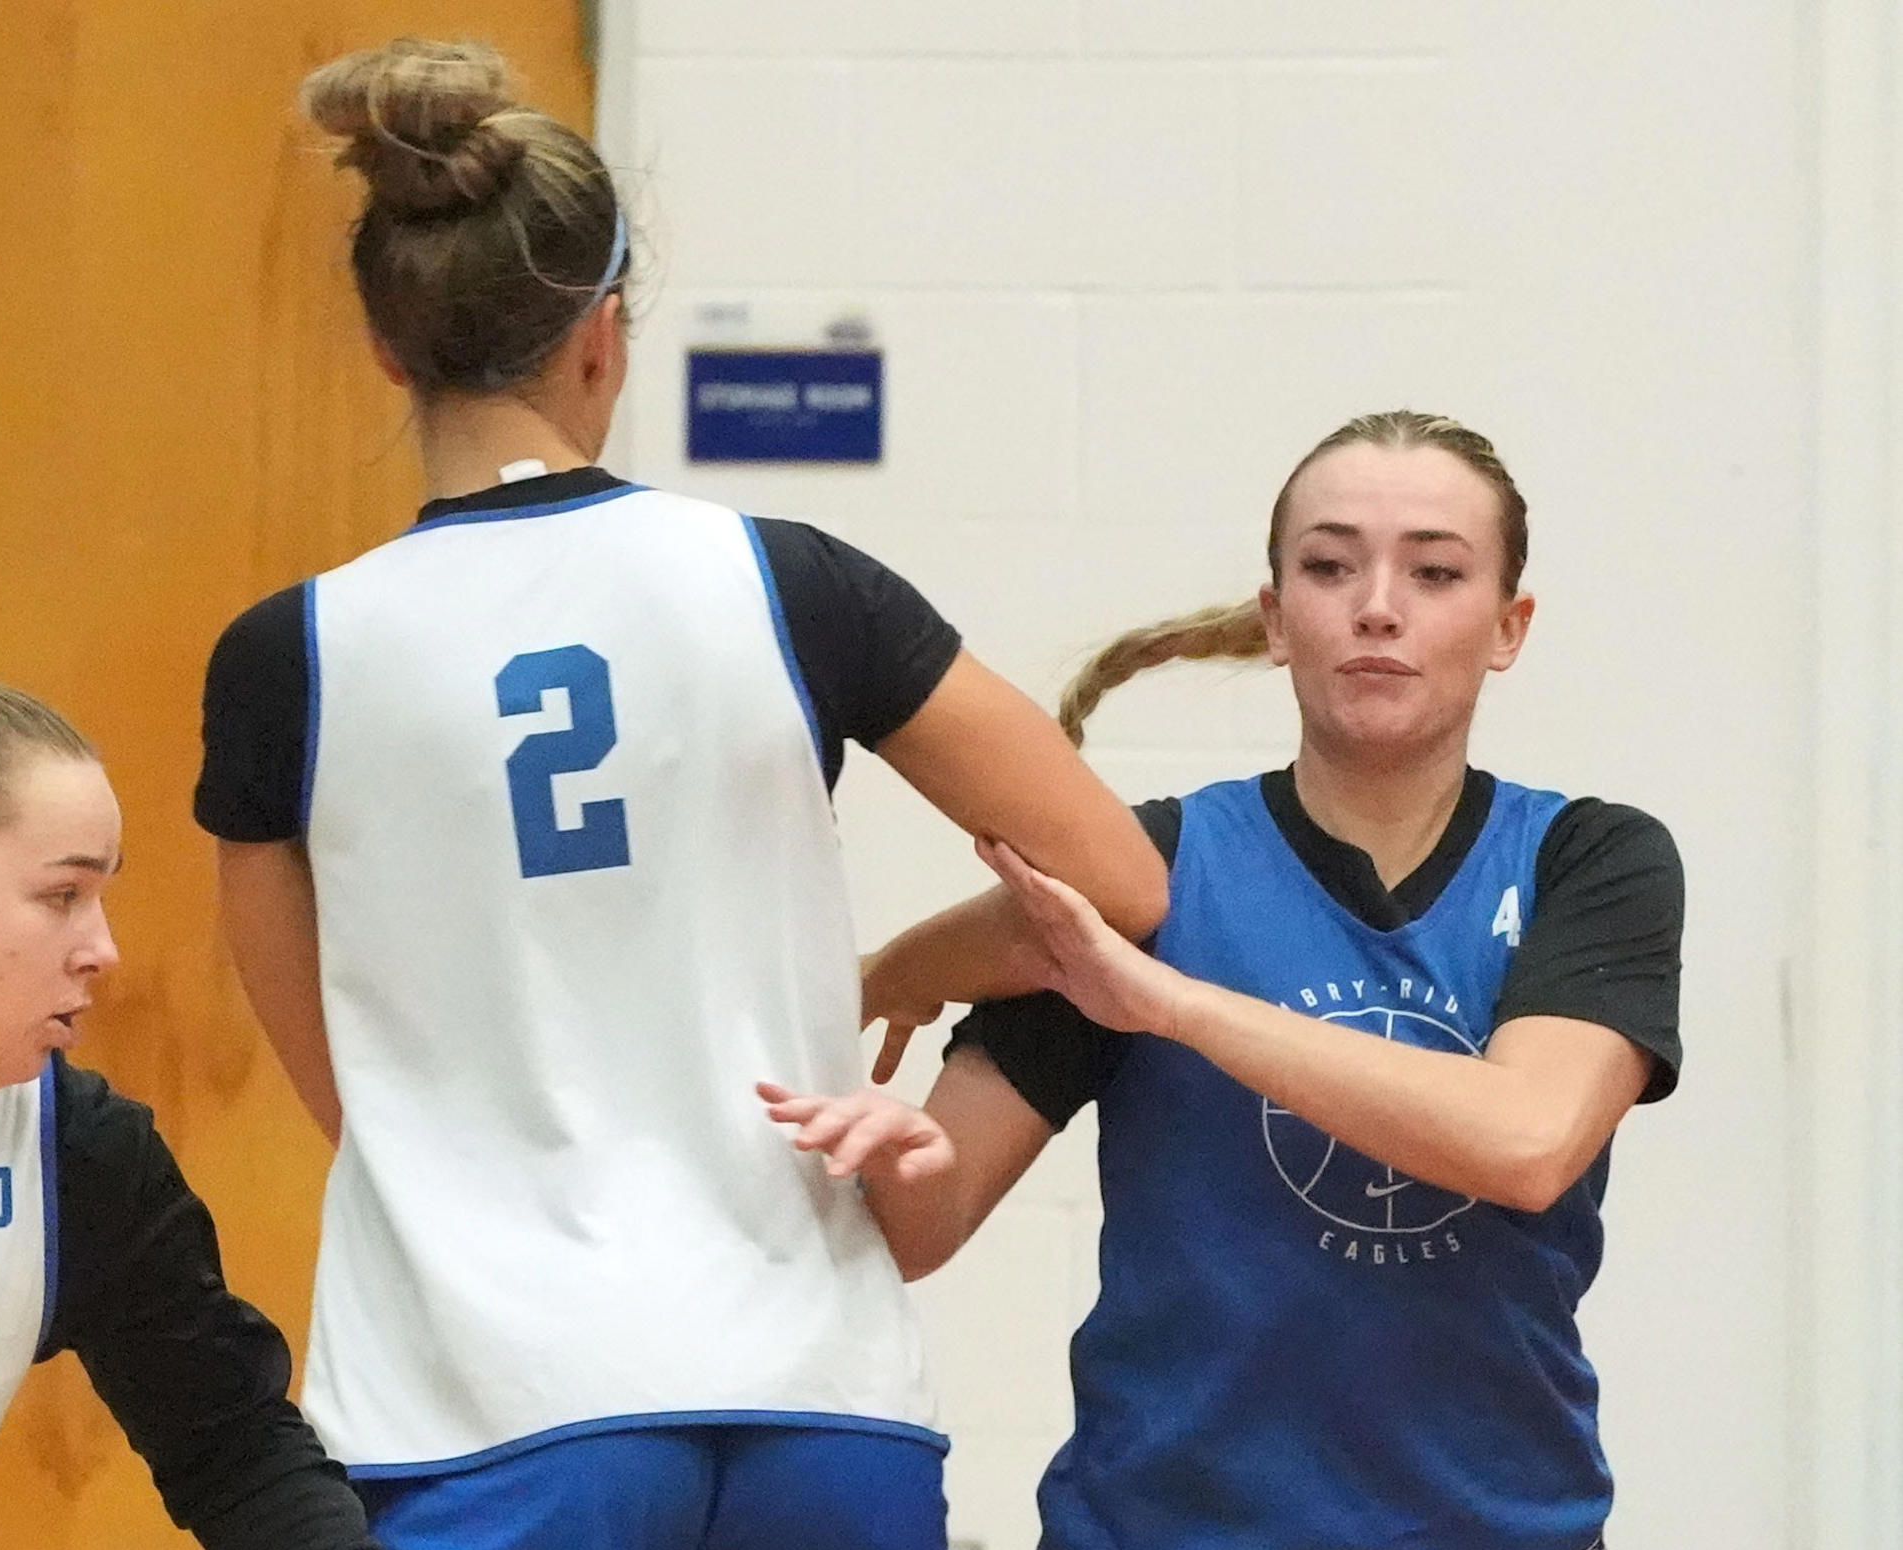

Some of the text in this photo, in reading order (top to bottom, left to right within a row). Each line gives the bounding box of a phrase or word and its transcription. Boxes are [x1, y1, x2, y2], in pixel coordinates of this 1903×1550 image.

[494, 643, 631, 879] 2
[1492, 885, 1522, 946] 4
[1318, 1231, 1462, 1264] EAGLES
